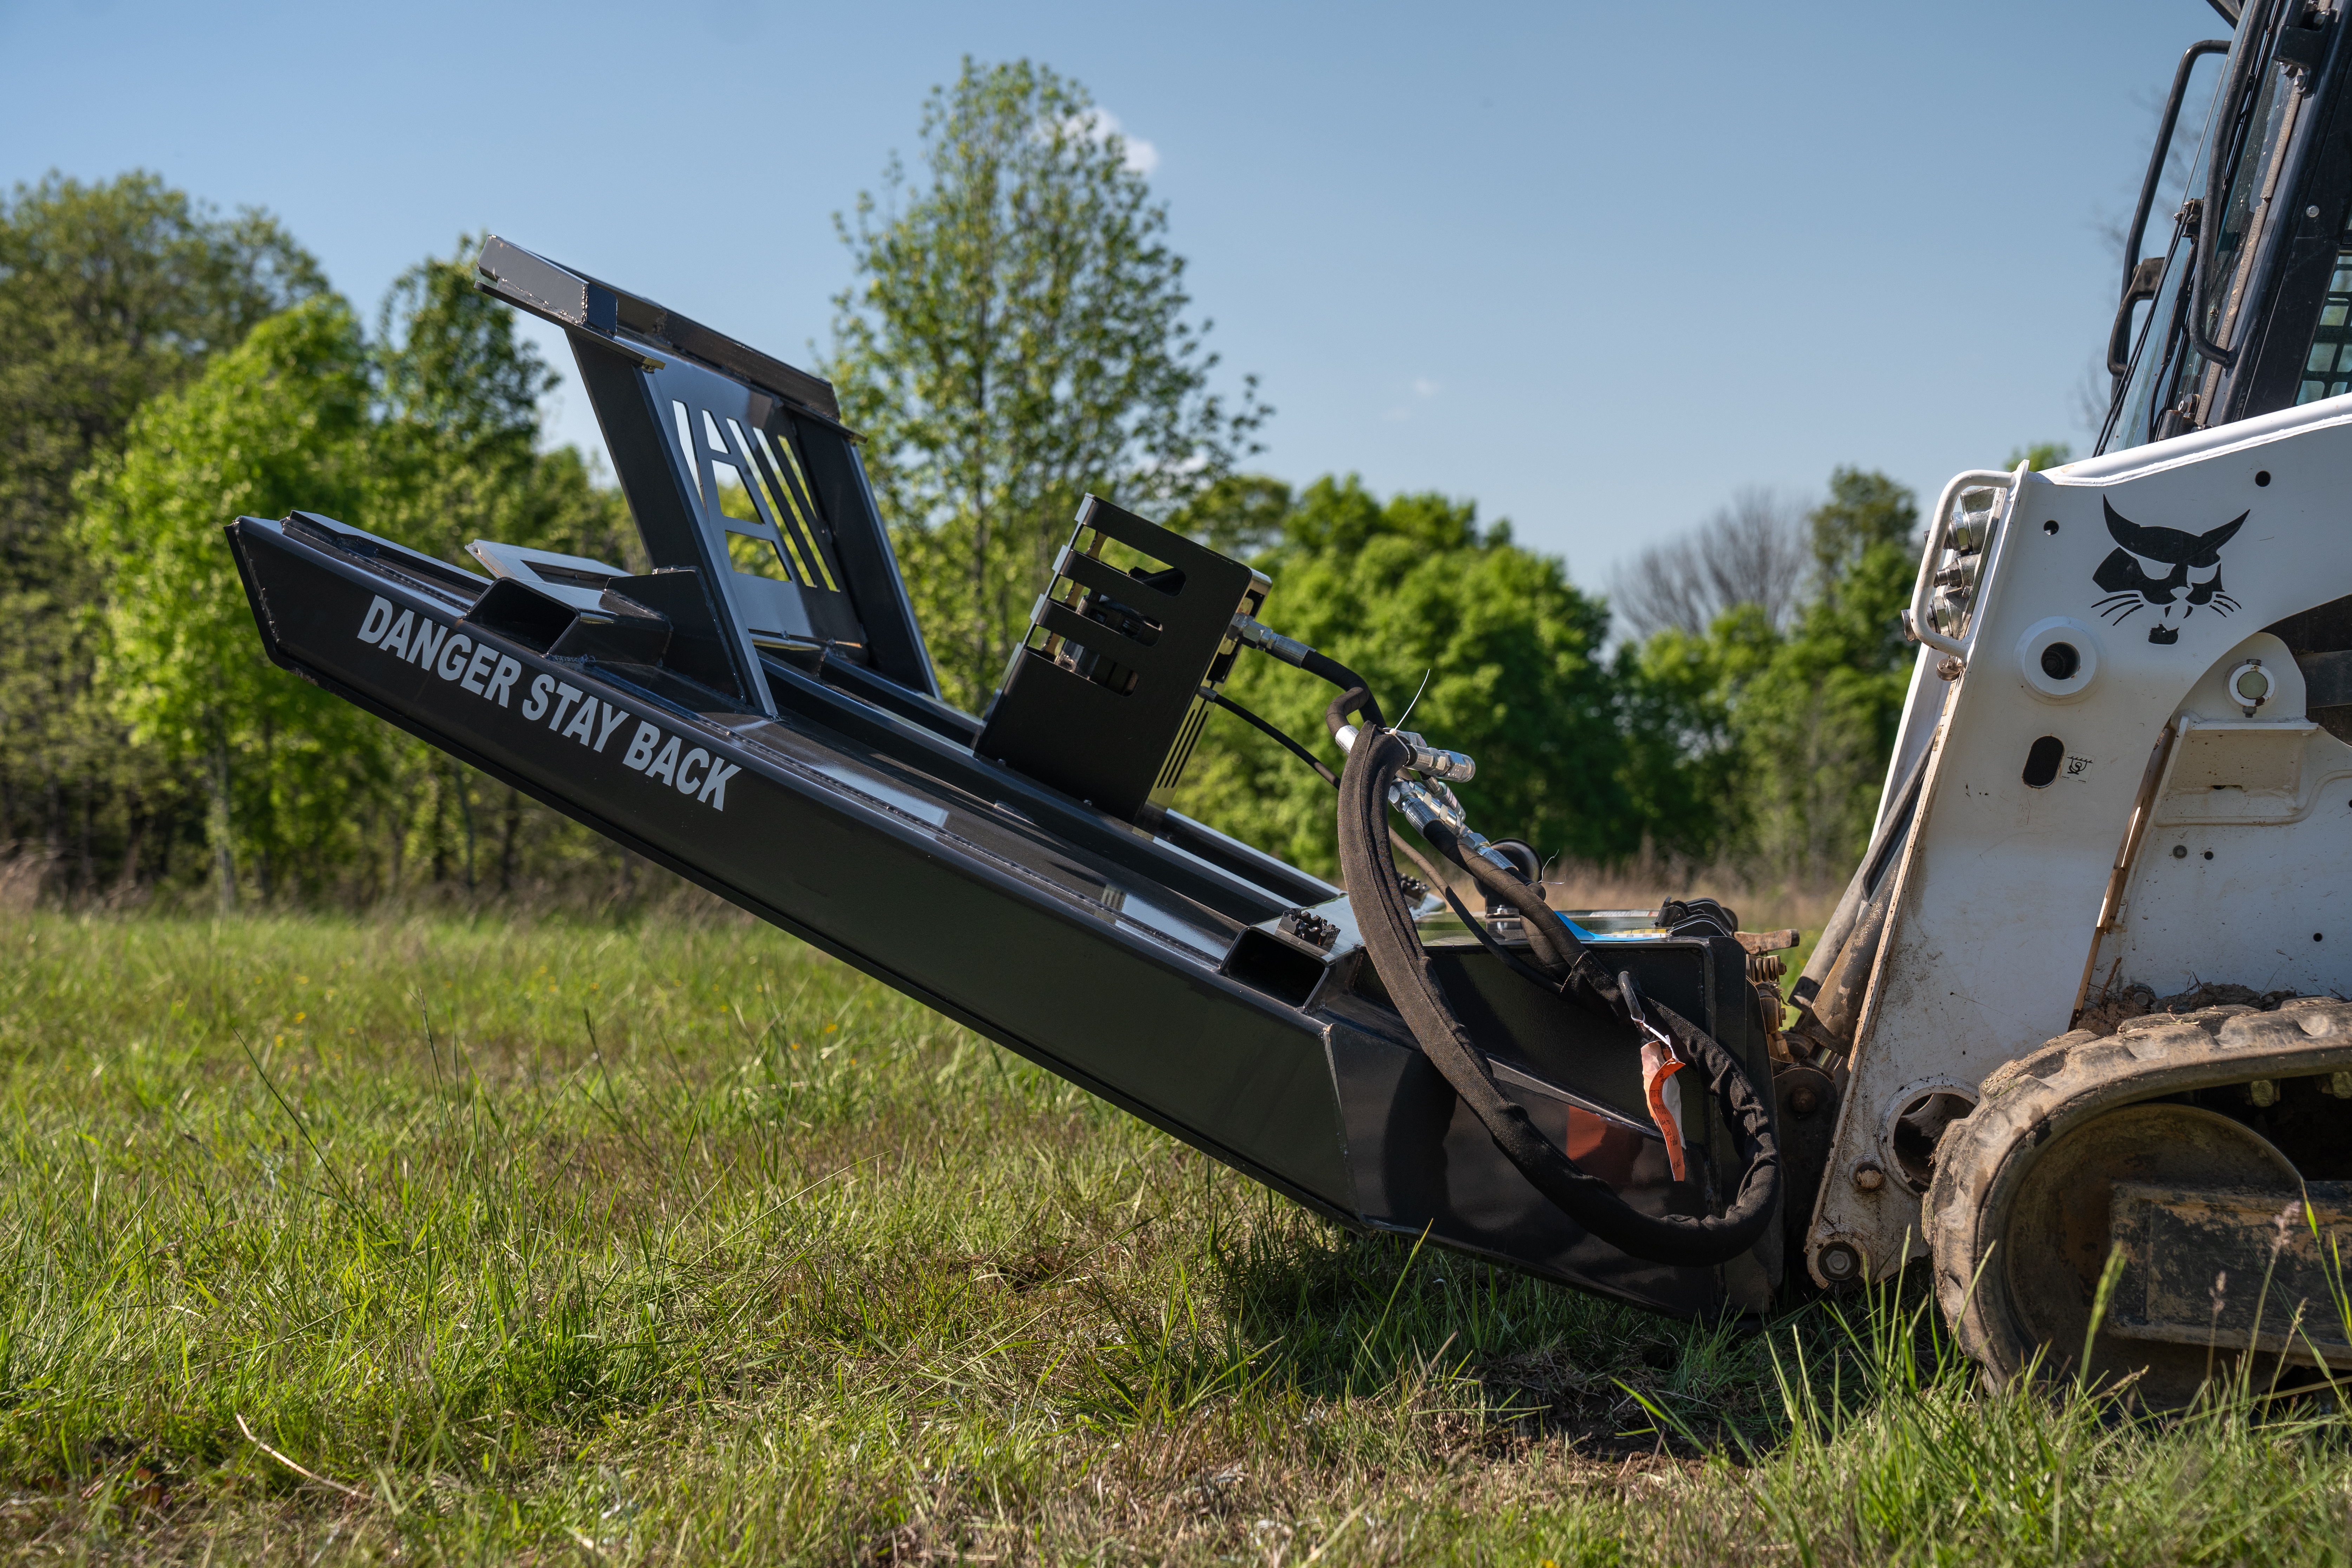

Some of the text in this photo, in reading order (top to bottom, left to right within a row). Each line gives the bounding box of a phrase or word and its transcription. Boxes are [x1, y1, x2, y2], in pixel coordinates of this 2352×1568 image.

[357, 595, 741, 811] DANGER STAY BACK
